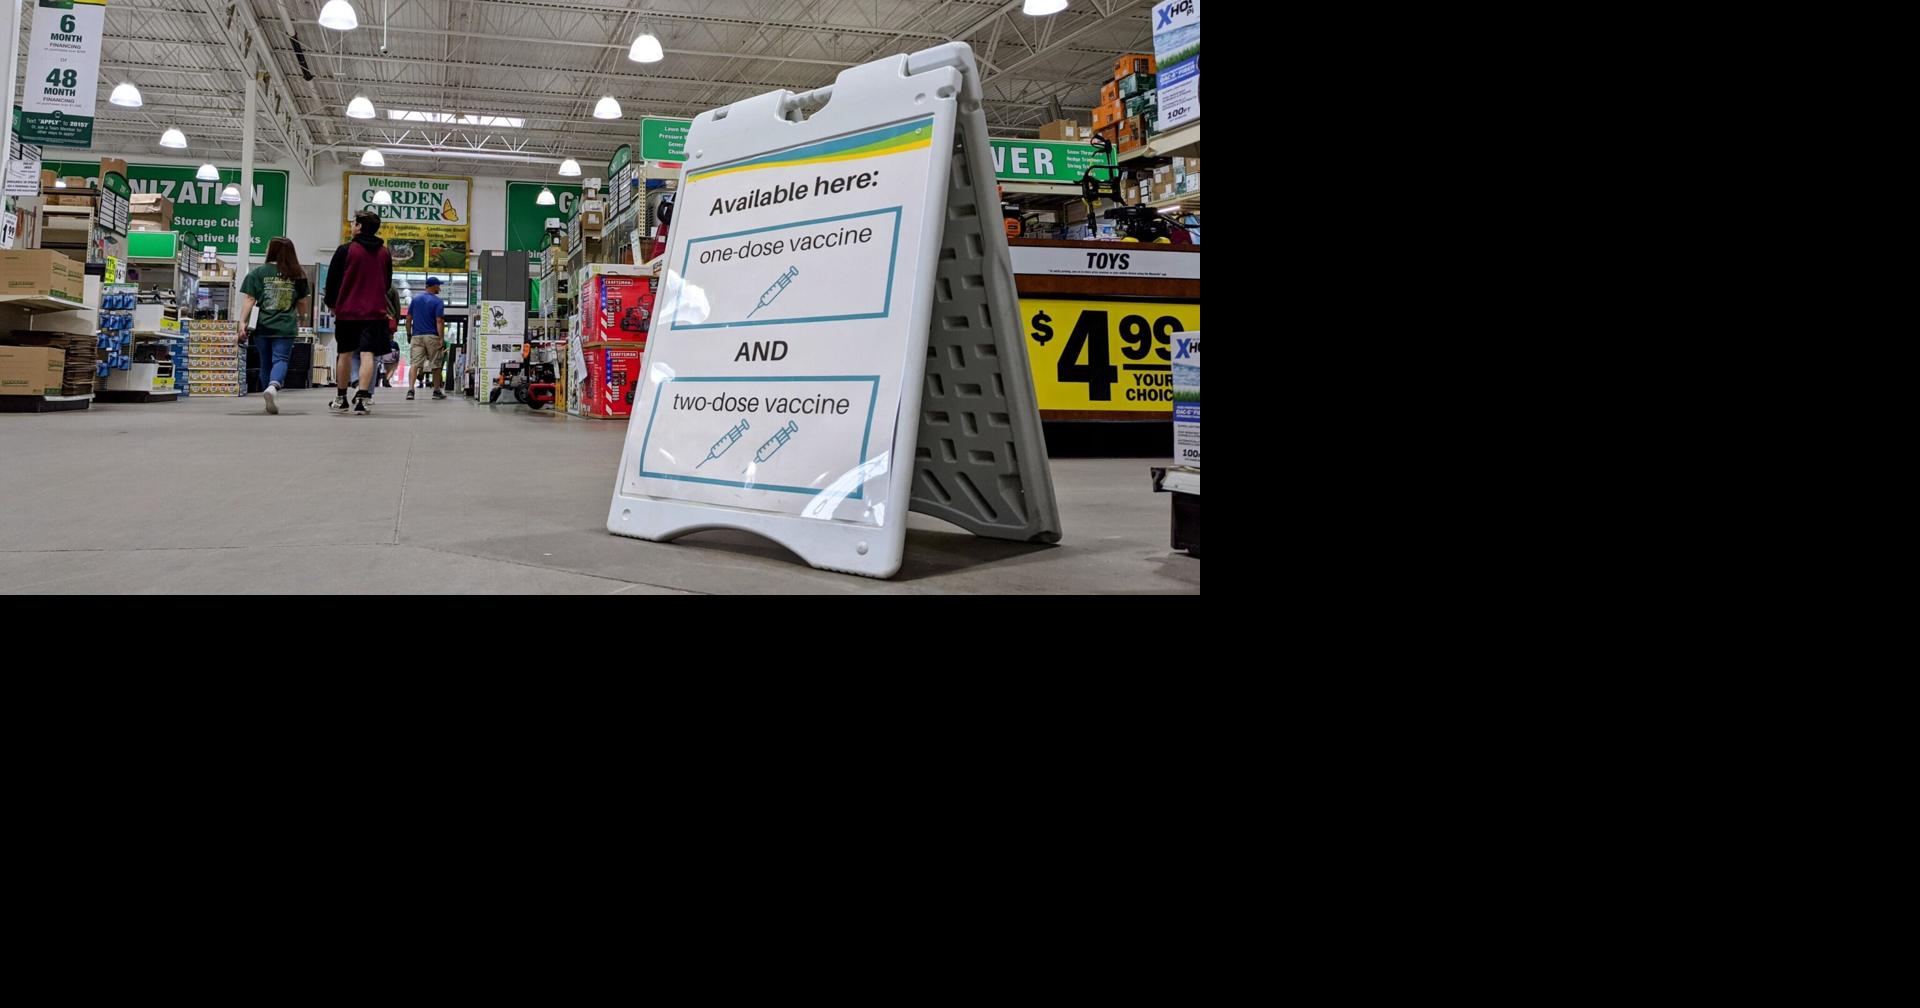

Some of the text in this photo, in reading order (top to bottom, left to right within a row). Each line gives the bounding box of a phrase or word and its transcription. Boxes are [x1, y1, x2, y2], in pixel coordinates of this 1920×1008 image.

[60, 14, 76, 33] 6
[50, 33, 82, 42] MONTH
[46, 68, 78, 88] 48
[44, 87, 76, 96] MONTH
[368, 178, 416, 189] Welcome
[420, 181, 429, 189] to
[362, 190, 443, 206] GRDEN
[710, 170, 878, 216] Available here:
[174, 217, 253, 228] Storage Cubs
[228, 234, 261, 244] Hoks
[700, 227, 872, 264] one-dose vaccine
[1086, 252, 1130, 270] TOYS
[734, 340, 788, 362] AND
[1133, 374, 1173, 386] YOUR
[1126, 389, 1174, 401] CHOIC
[673, 392, 850, 415] two-dose vaccine
